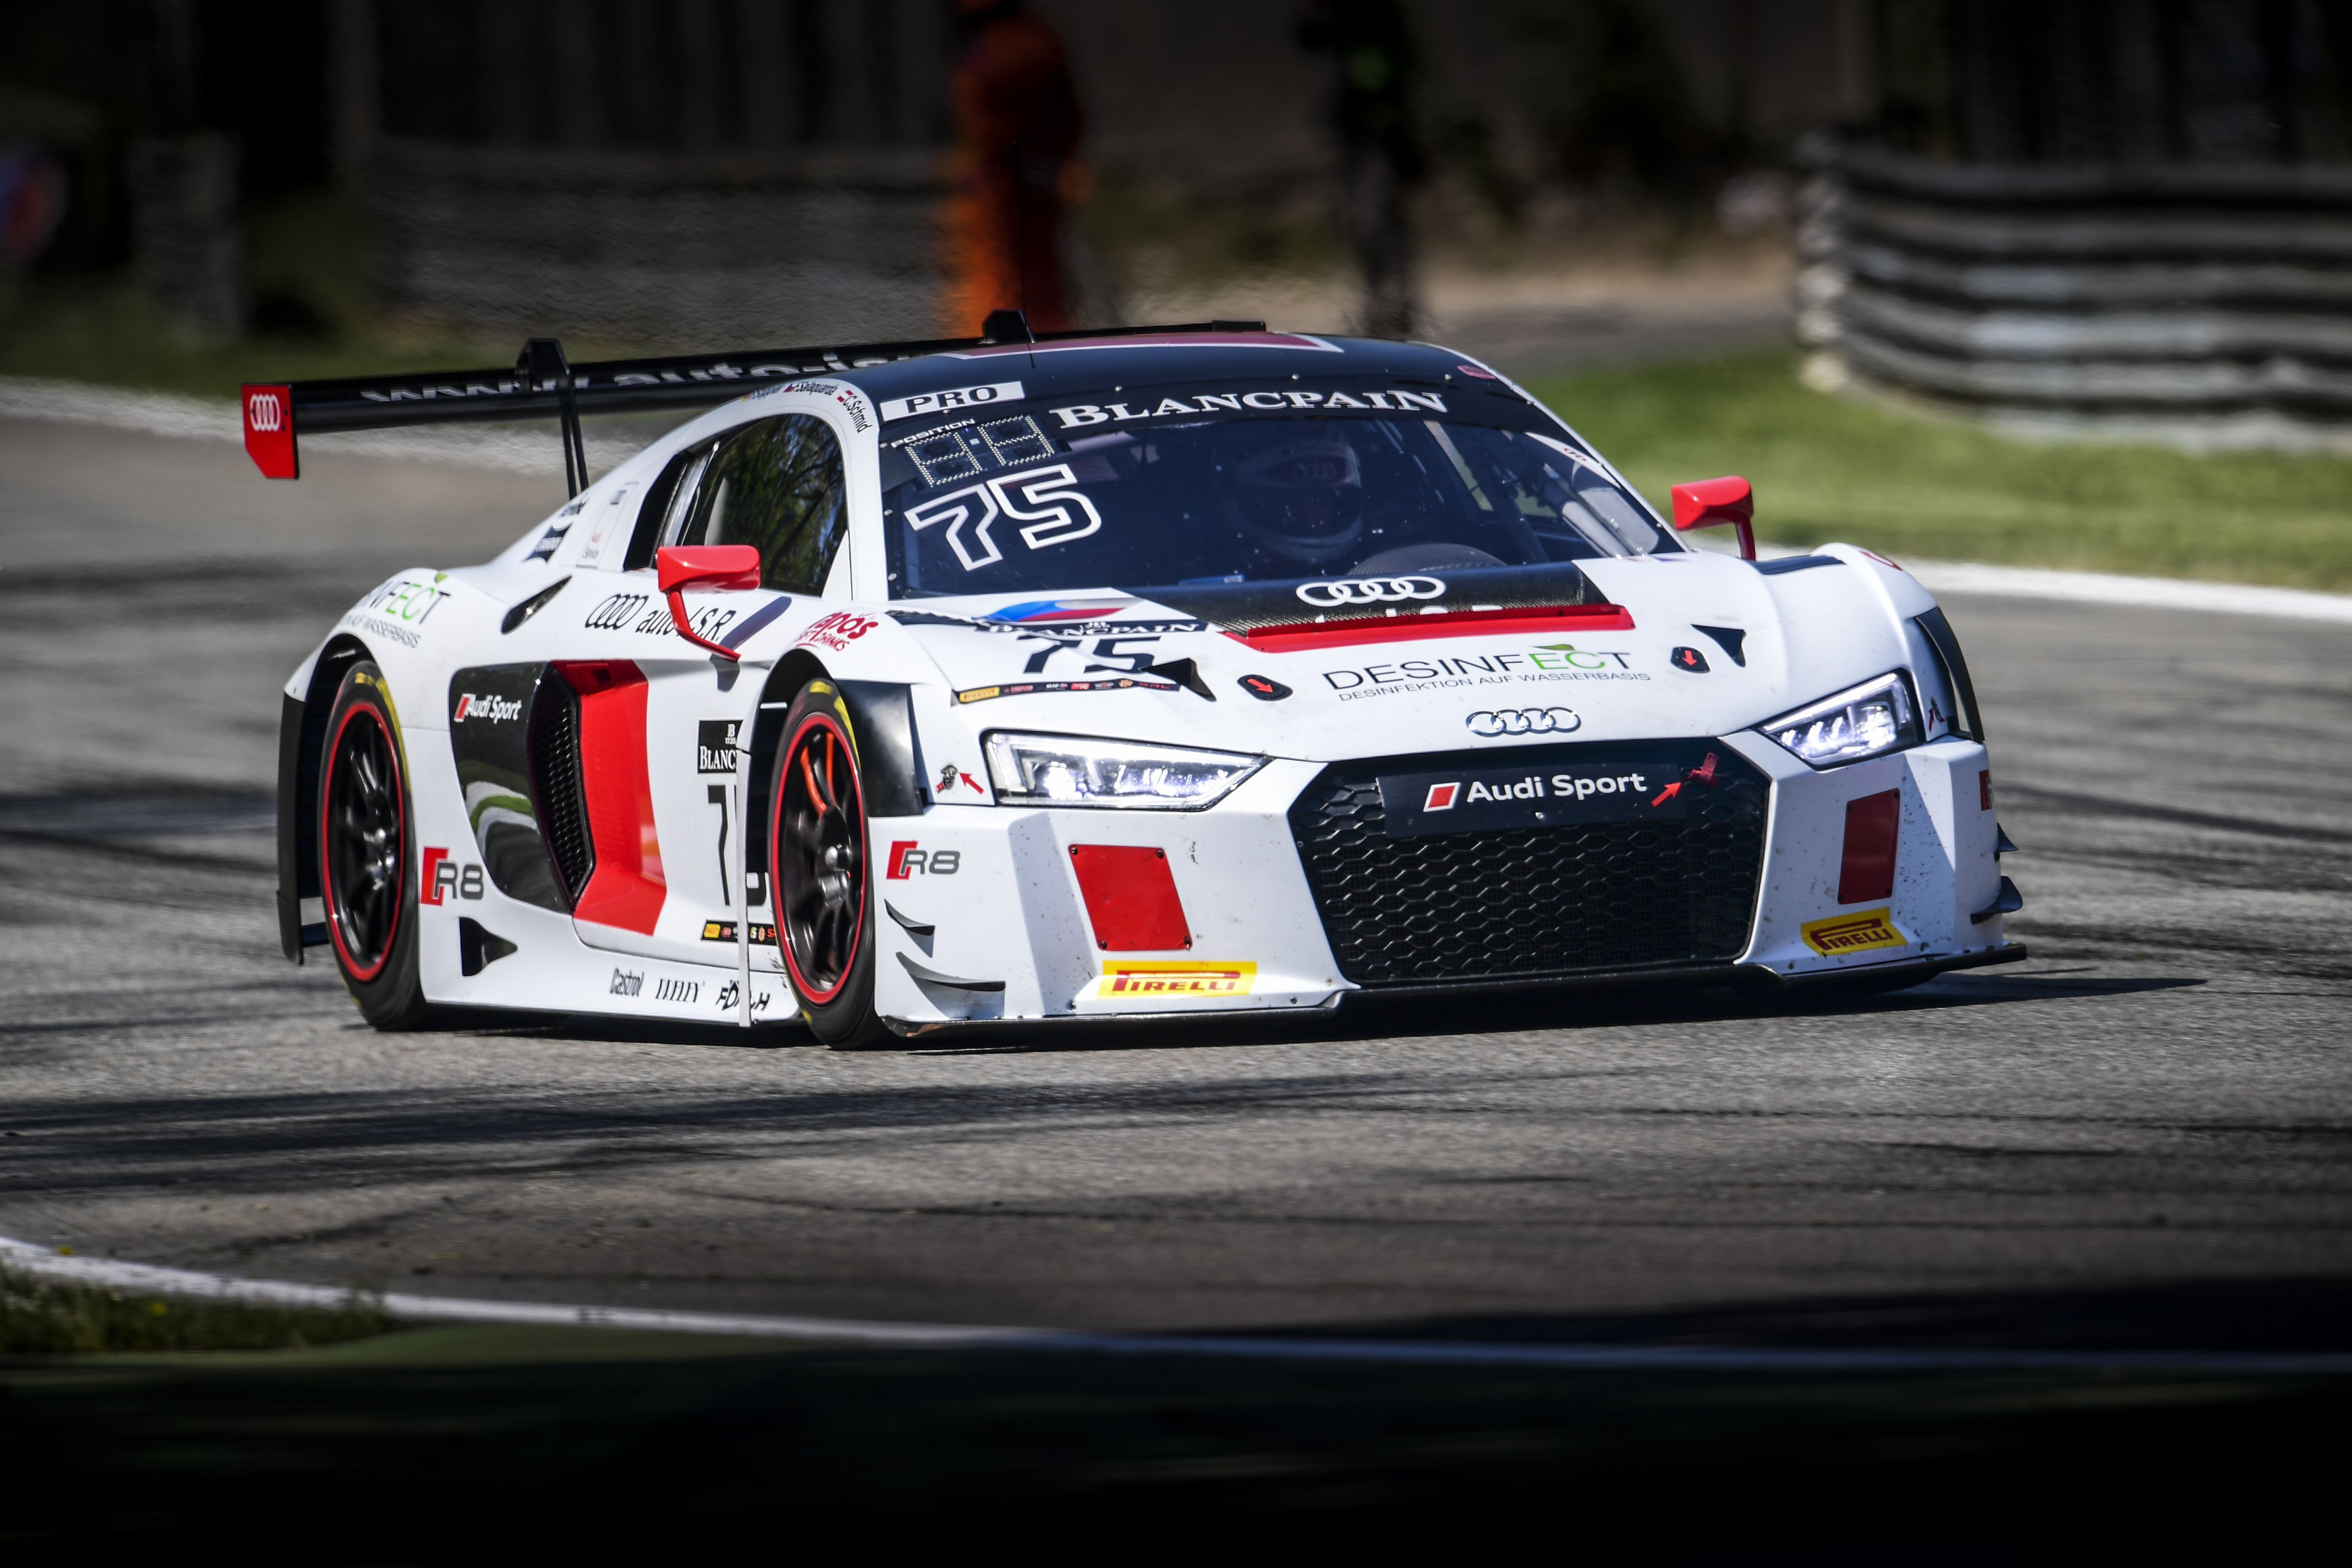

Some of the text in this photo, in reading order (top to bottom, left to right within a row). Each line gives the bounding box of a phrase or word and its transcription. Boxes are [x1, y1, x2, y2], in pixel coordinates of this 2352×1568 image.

[905, 387, 998, 414] PRO
[1049, 390, 1448, 429] BLANCPAIN
[891, 418, 976, 448] POSITION
[904, 463, 1102, 572] 75
[1016, 634, 1162, 675] 75
[1322, 651, 1630, 690] DESINFECT
[1339, 672, 1651, 702] DESINFEKTION AUF WASSERBASIS
[464, 693, 522, 724] Audi Sport
[700, 746, 737, 770] BLANC
[1466, 772, 1647, 803] Audi Sport
[898, 849, 961, 876] R8
[433, 860, 485, 901] R8
[1810, 917, 1895, 952] PIRELLI
[610, 967, 644, 997] Castrol
[1112, 970, 1241, 991] PIRELLI
